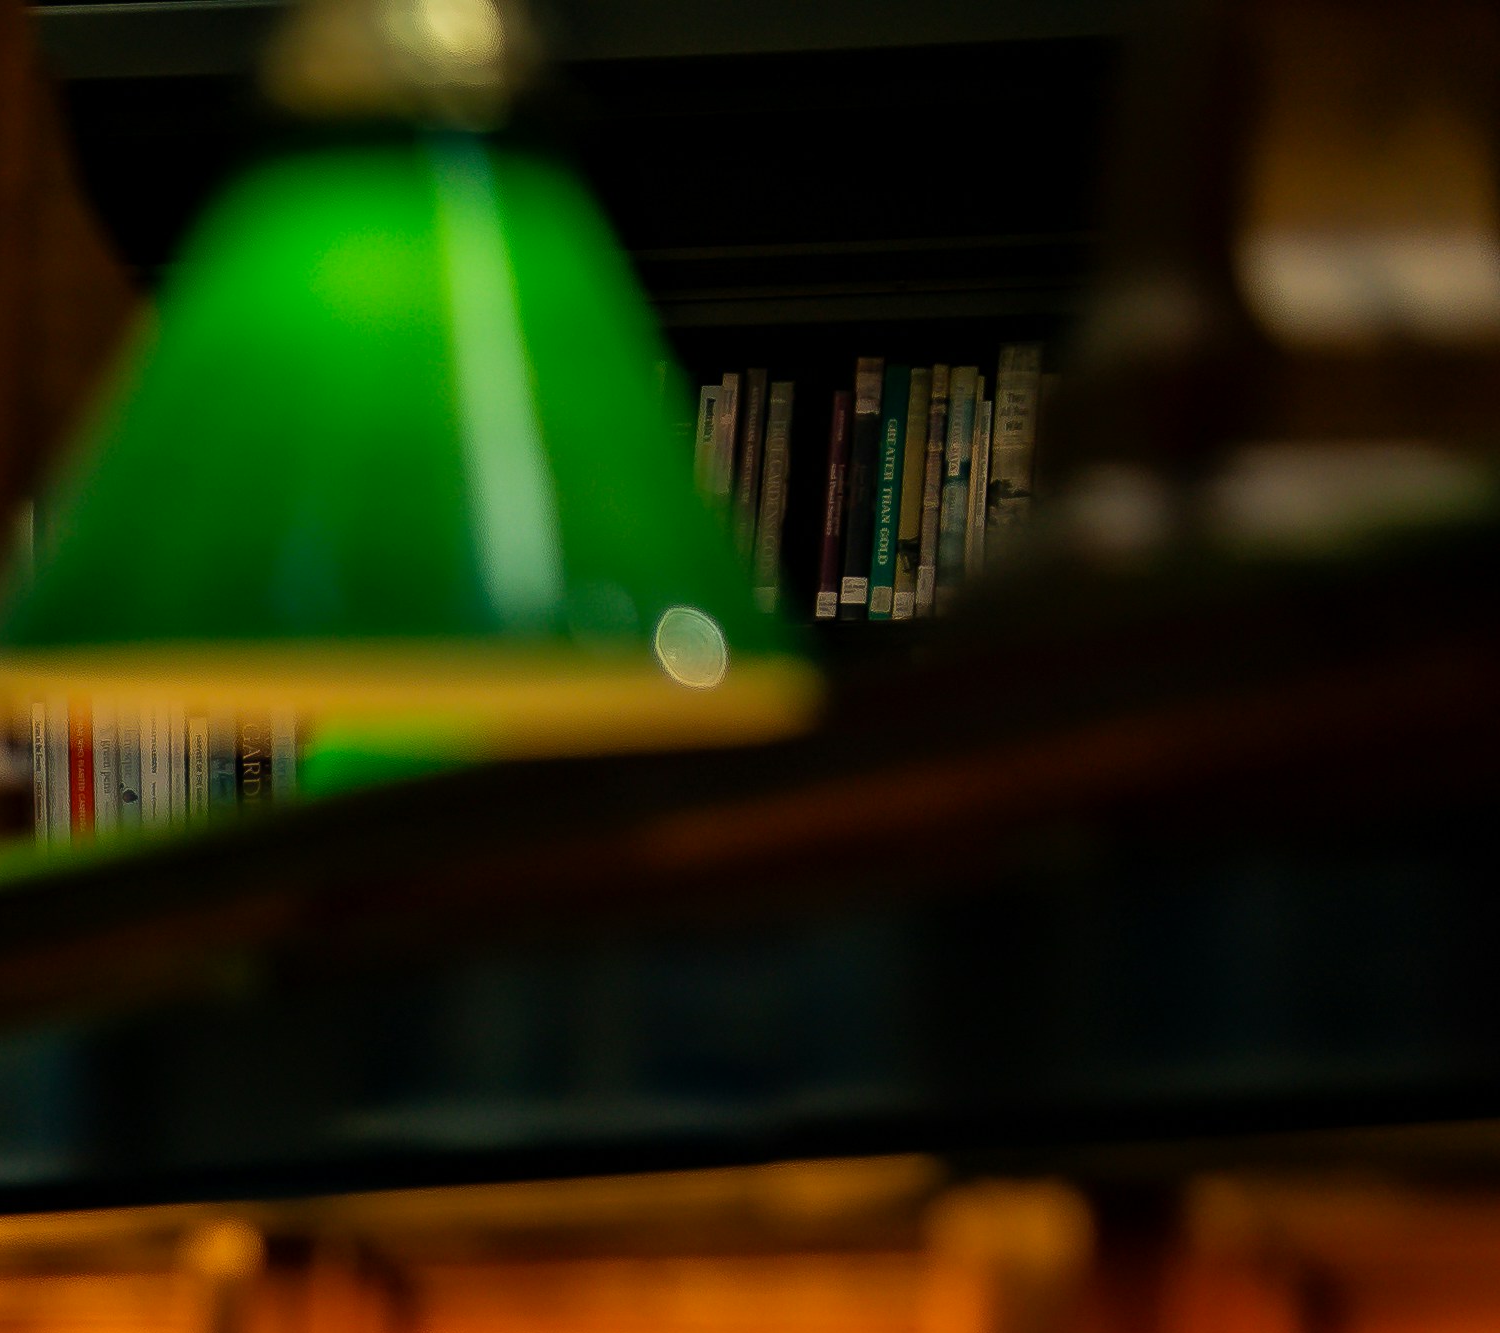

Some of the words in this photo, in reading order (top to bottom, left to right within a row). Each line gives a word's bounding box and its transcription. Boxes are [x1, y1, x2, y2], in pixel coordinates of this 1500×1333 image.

[884, 418, 897, 481] GREATER
[881, 486, 893, 523] THAN
[877, 527, 890, 566] GOLD
